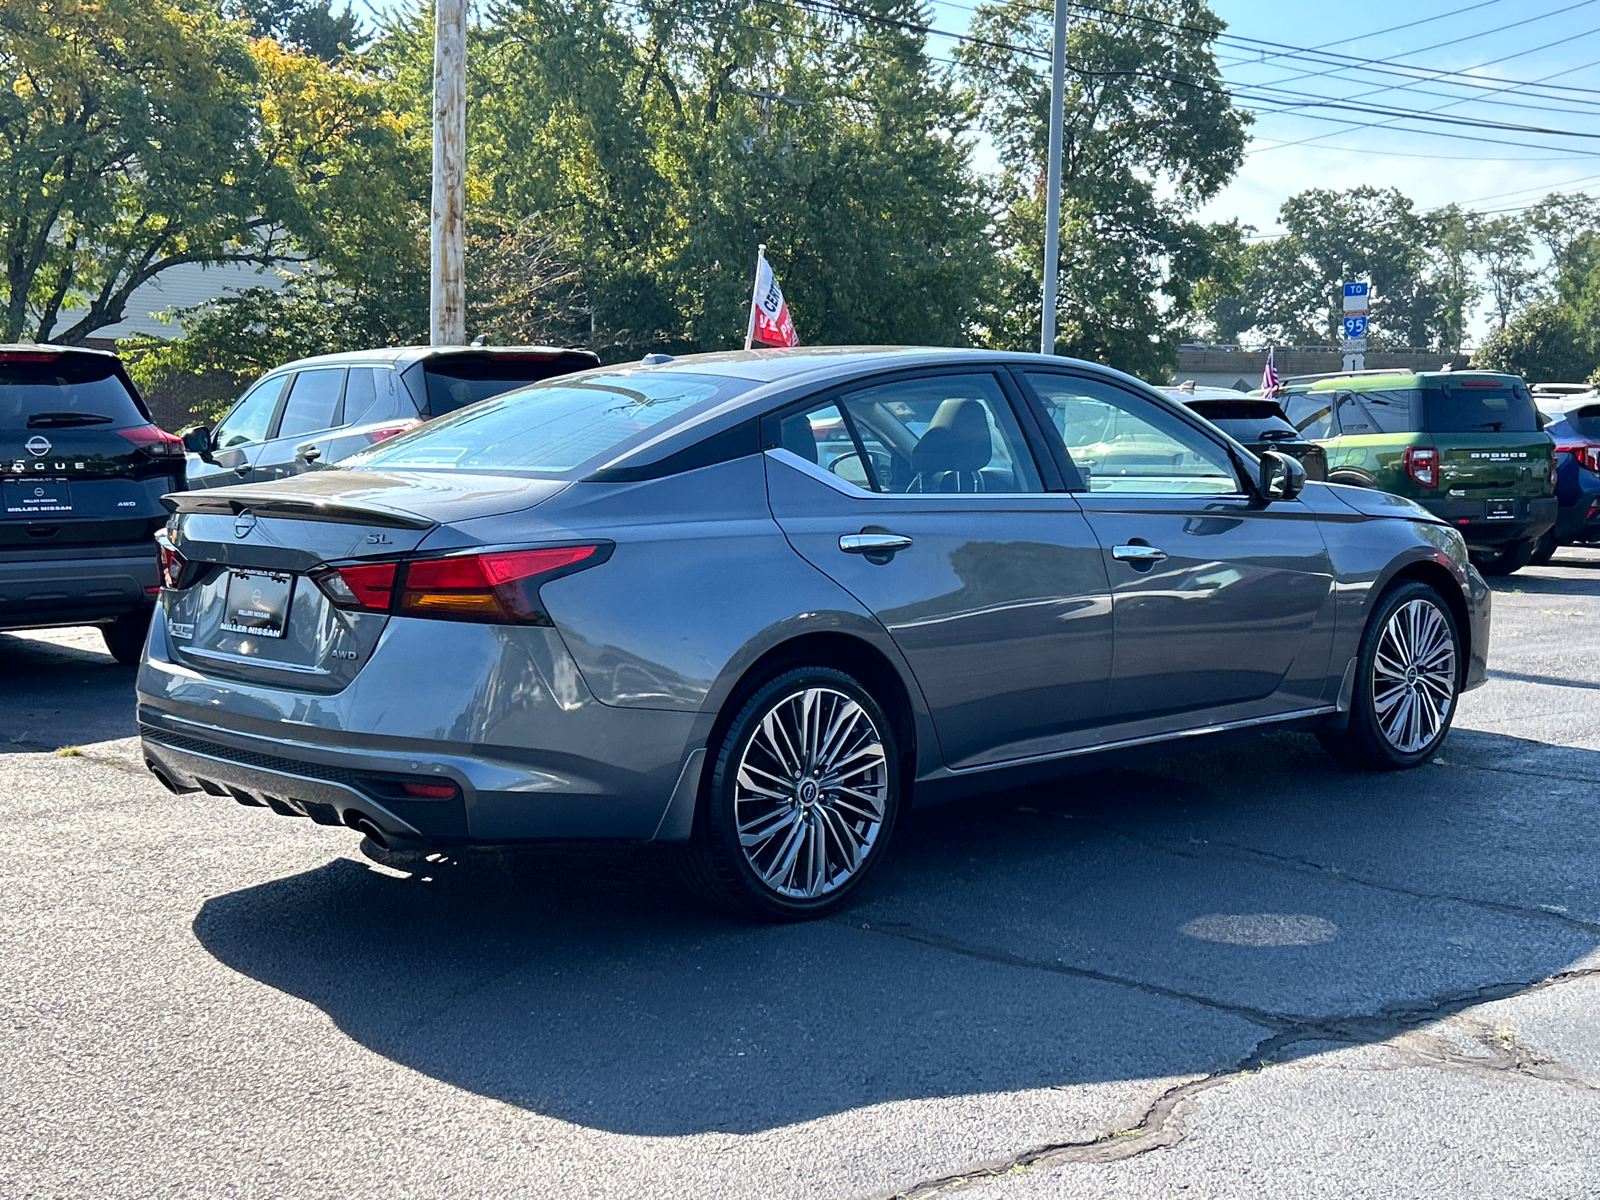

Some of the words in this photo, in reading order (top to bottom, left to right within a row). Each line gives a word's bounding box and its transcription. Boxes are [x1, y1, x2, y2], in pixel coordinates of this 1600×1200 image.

[1350, 285, 1362, 294] TO
[1346, 319, 1364, 333] 95
[1343, 341, 1365, 350] SOUTH
[0, 462, 85, 470] OGUE
[366, 533, 393, 545] SL
[238, 609, 254, 617] MILLER
[254, 611, 270, 619] NISSAN
[220, 622, 247, 633] MILLER
[247, 626, 280, 638] NISSAN
[331, 649, 359, 661] AWD
